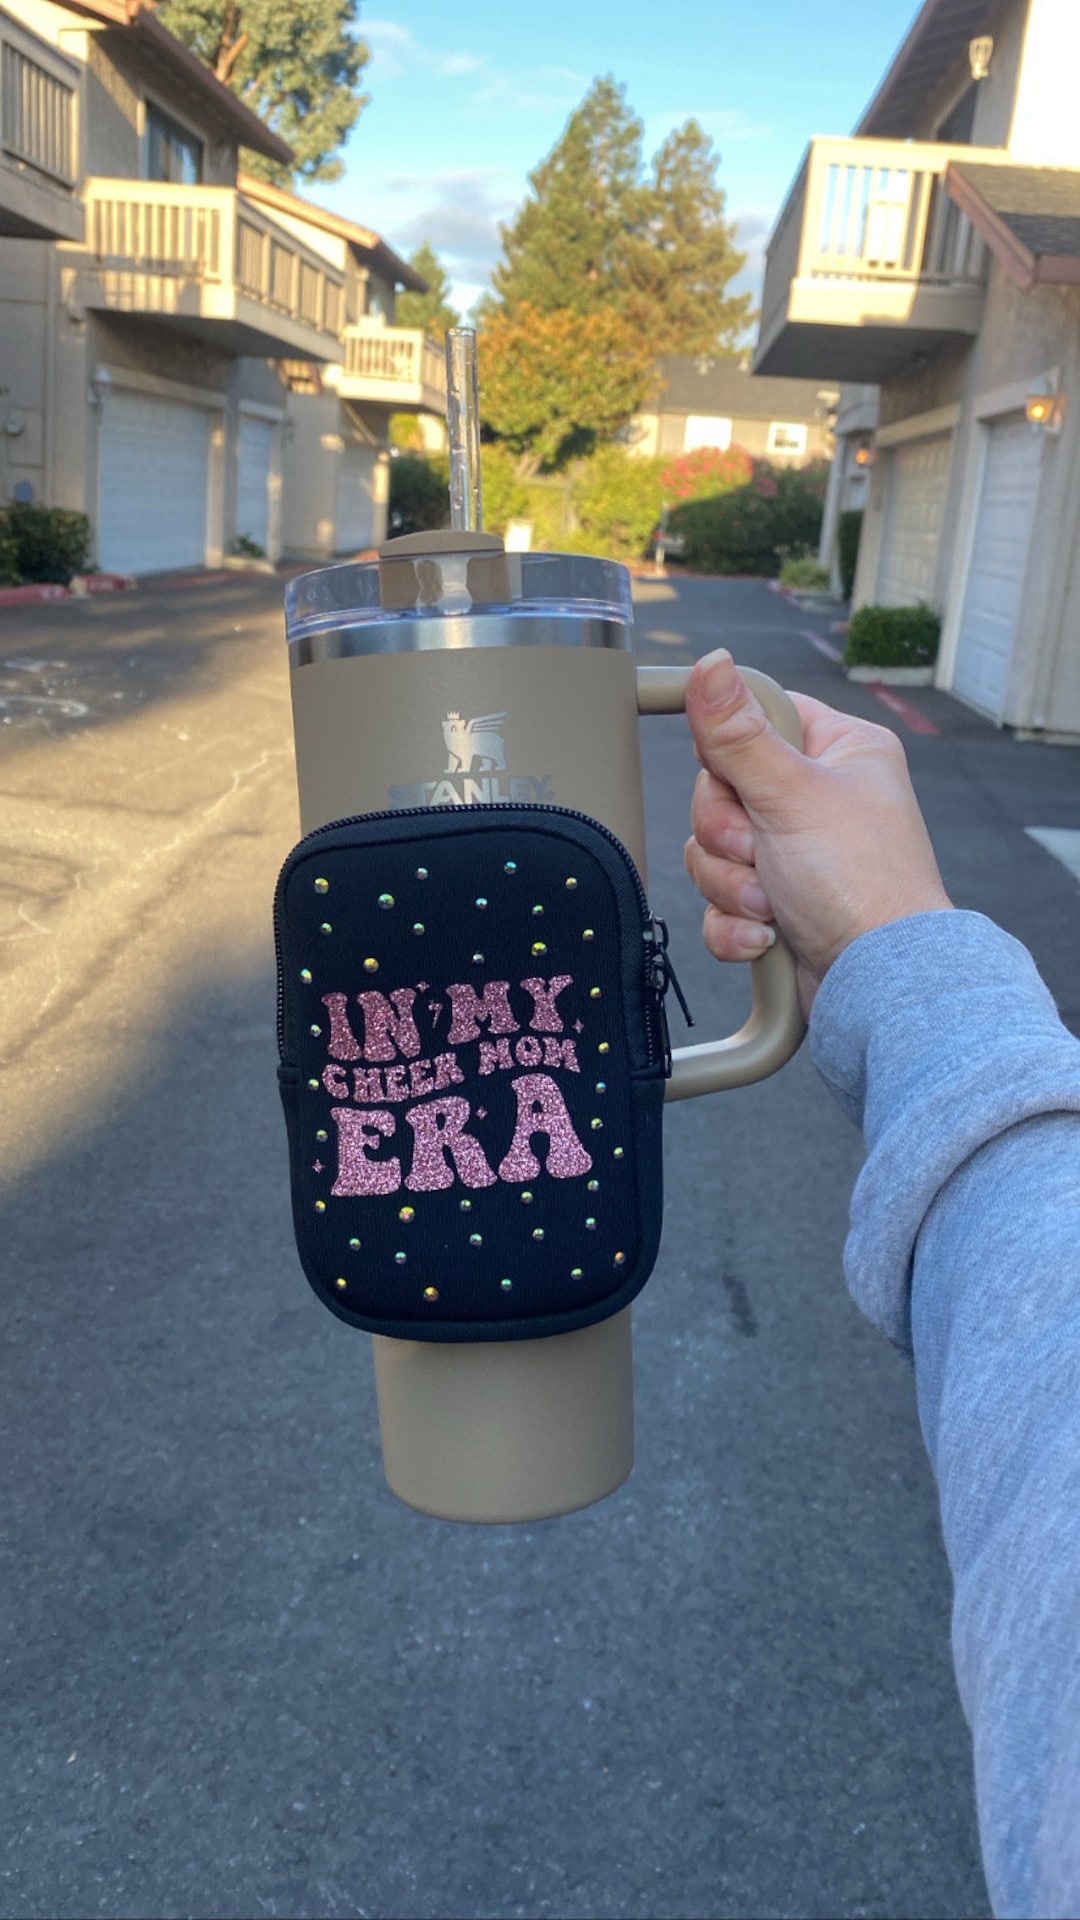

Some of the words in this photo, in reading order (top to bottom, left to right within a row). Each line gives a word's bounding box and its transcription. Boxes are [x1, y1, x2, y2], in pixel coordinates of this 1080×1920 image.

[388, 775, 553, 809] STANLEY
[322, 988, 422, 1062] IN
[446, 975, 573, 1044] MY
[322, 1053, 465, 1102] CHEER
[478, 1036, 581, 1075] MOM
[330, 1073, 593, 1197] ERA
